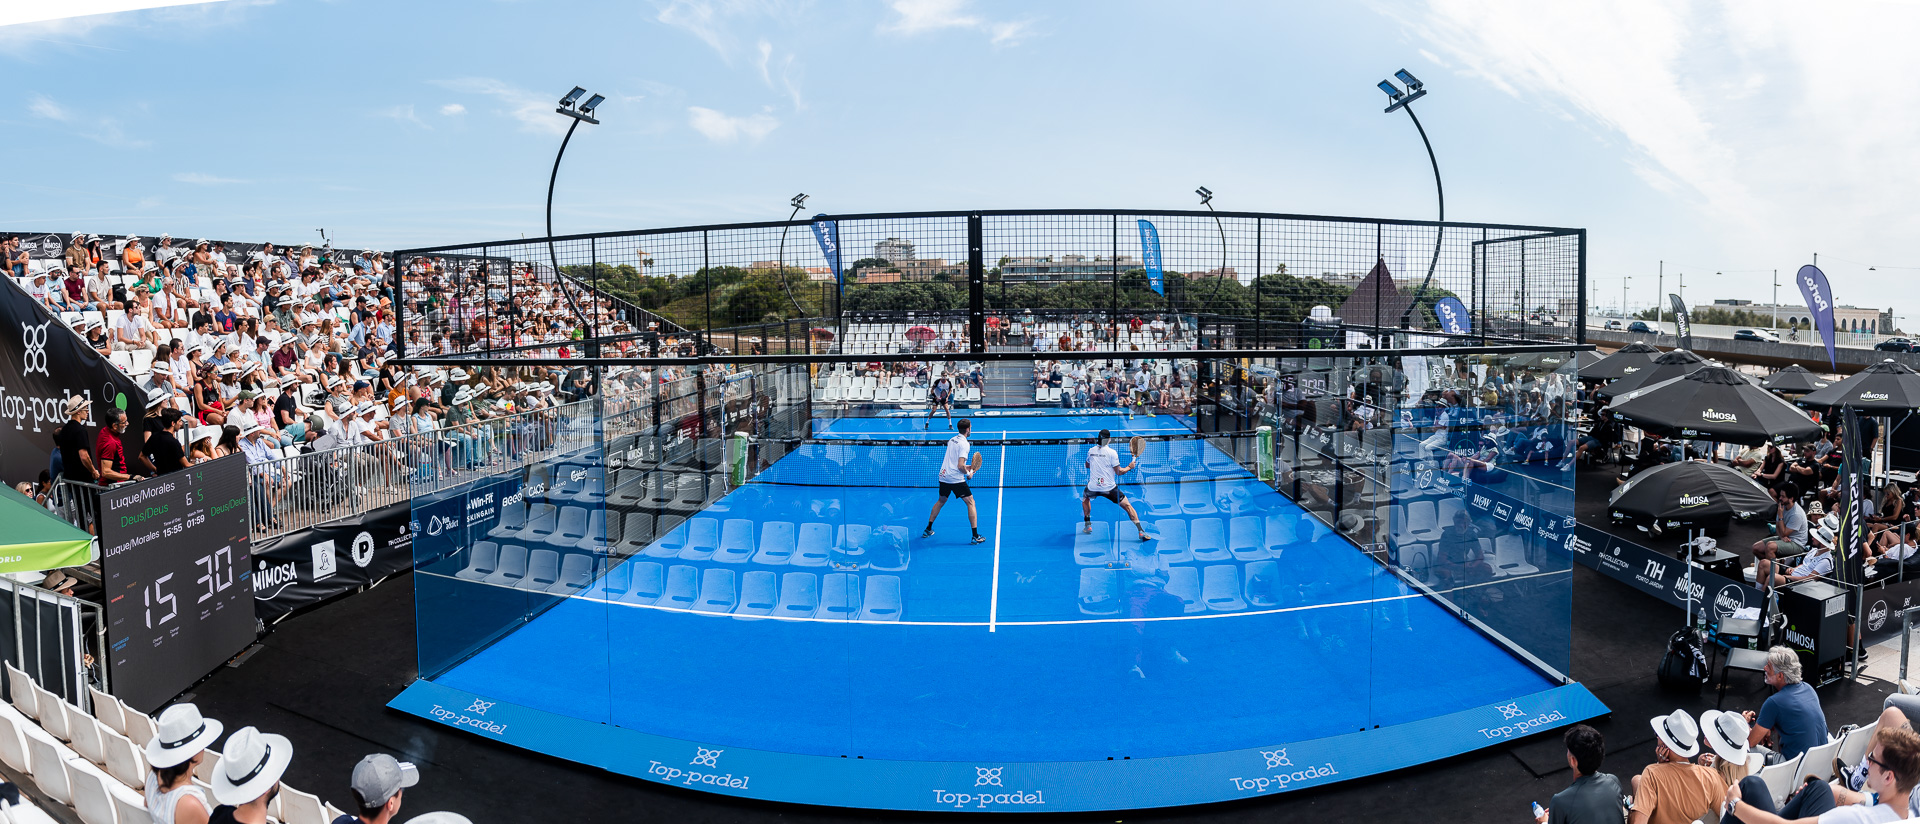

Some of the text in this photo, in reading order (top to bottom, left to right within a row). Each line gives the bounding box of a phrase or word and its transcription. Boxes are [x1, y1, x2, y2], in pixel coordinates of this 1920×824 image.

[1860, 391, 1889, 400] MIMOSA
[0, 386, 96, 433] Top-padl
[1702, 408, 1737, 421] MIMOSA
[1682, 427, 1698, 436] MIMOSA
[110, 471, 203, 510] Luque/Morales 7 4
[528, 482, 545, 497] CAOS
[1680, 493, 1709, 505] MIMOSA
[120, 489, 204, 528] Deus/Deus 6 5
[210, 496, 247, 517] Deus/Deus
[470, 492, 494, 510] Win-Fit
[1473, 494, 1492, 508] WOW
[186, 514, 205, 529] 01:59
[466, 507, 495, 523] SKINGAIN
[1513, 508, 1534, 528] MIMOSA
[162, 523, 183, 538] 15:55
[1538, 526, 1560, 541] Top-padel
[105, 529, 160, 558] Luque/Morales
[195, 545, 234, 604] 30
[252, 560, 298, 593] MIMOSA
[1635, 574, 1664, 591] PORTO JARDIM
[1674, 573, 1706, 600] MIMOSA
[144, 572, 178, 629] 15
[1716, 590, 1742, 611] MIMOSA
[1870, 608, 1886, 620] MIMOSA
[1785, 624, 1816, 651] MIMOSA
[429, 703, 508, 735] Top-padel
[1477, 709, 1567, 739] Top-padel
[648, 759, 750, 790] Top-padel
[1229, 762, 1339, 793] Top-padel
[932, 789, 1046, 808] Top-padel
